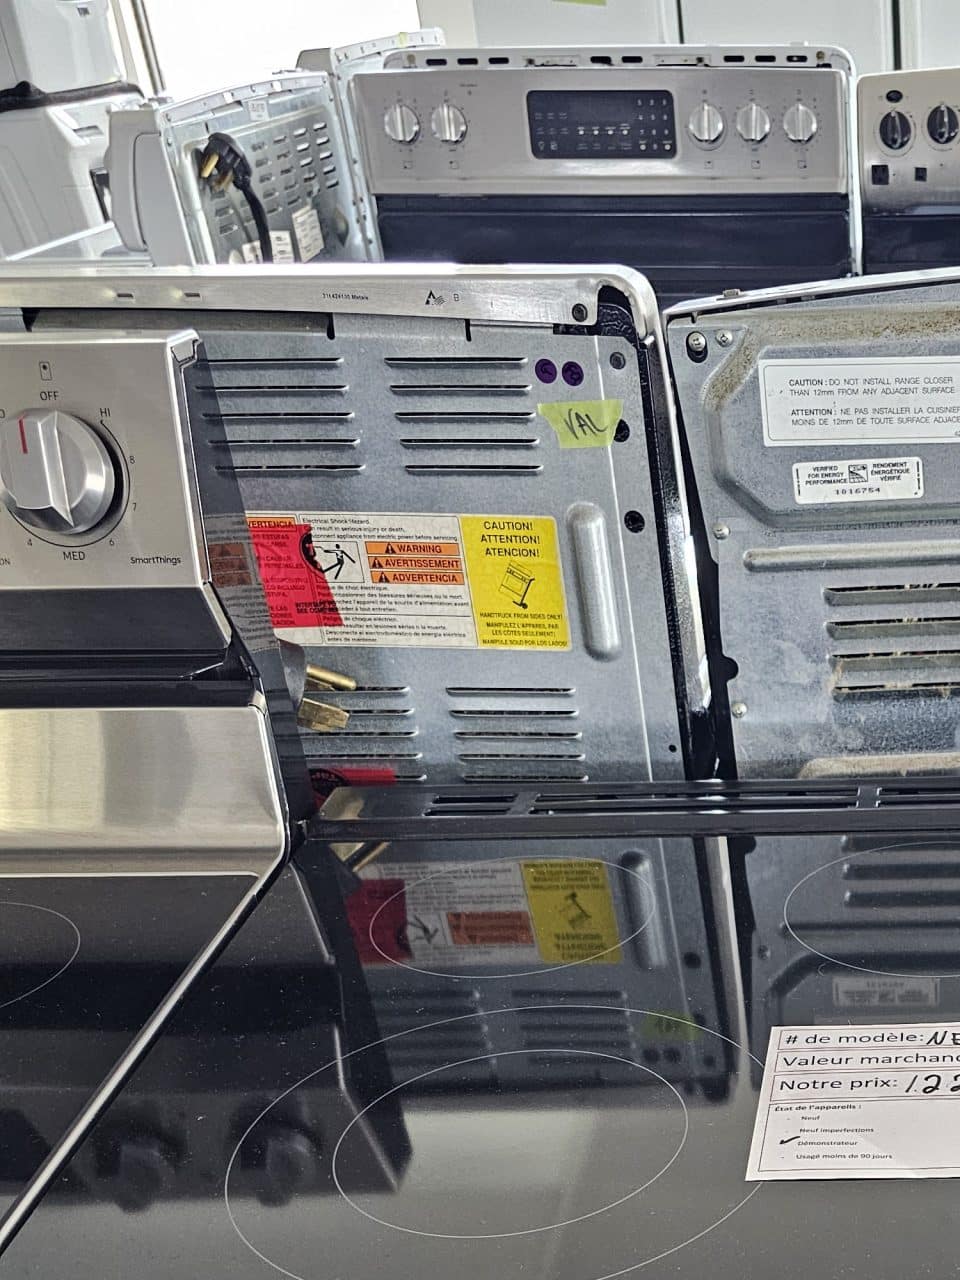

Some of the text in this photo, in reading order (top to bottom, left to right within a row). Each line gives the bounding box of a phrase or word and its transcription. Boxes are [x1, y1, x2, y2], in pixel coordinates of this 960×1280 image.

[40, 391, 60, 401] OFF
[100, 408, 111, 418] HI
[564, 408, 608, 440] VAL
[897, 416, 930, 424] SURFACE
[130, 455, 136, 464] 8
[871, 468, 910, 476] ÉNERGÉTIQUE
[132, 502, 138, 511] 7
[484, 521, 533, 530] CAUTION!
[481, 534, 540, 544] ATTENTION!
[397, 544, 442, 554] WARNING
[486, 548, 540, 558] ATENCION!
[63, 551, 86, 561] MED
[130, 556, 182, 566] SmartThings
[385, 558, 460, 568] AVERTISSEMENT
[392, 574, 458, 583] ADVERTENCIA
[786, 1034, 799, 1045] #
[805, 1033, 831, 1045] de
[844, 1031, 924, 1044] modèle:
[782, 1055, 854, 1066] Valeur
[780, 1080, 842, 1091] Notre
[850, 1076, 898, 1090] prix:
